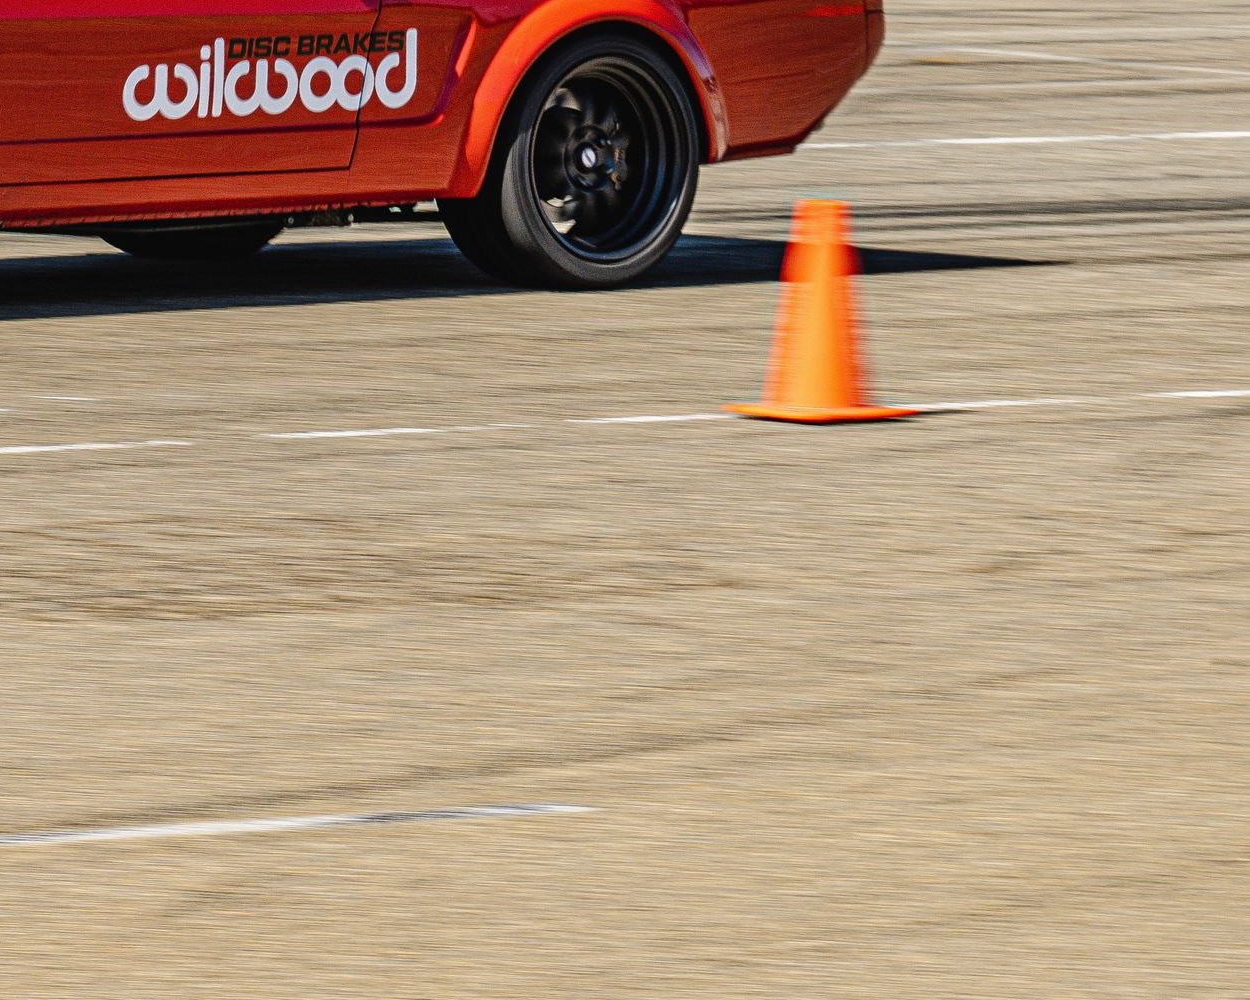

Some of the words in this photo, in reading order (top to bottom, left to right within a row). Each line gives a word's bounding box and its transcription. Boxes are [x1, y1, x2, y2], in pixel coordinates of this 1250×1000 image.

[122, 28, 418, 122] wilwood
[228, 36, 290, 60] DISC
[296, 30, 406, 57] BRAKES
